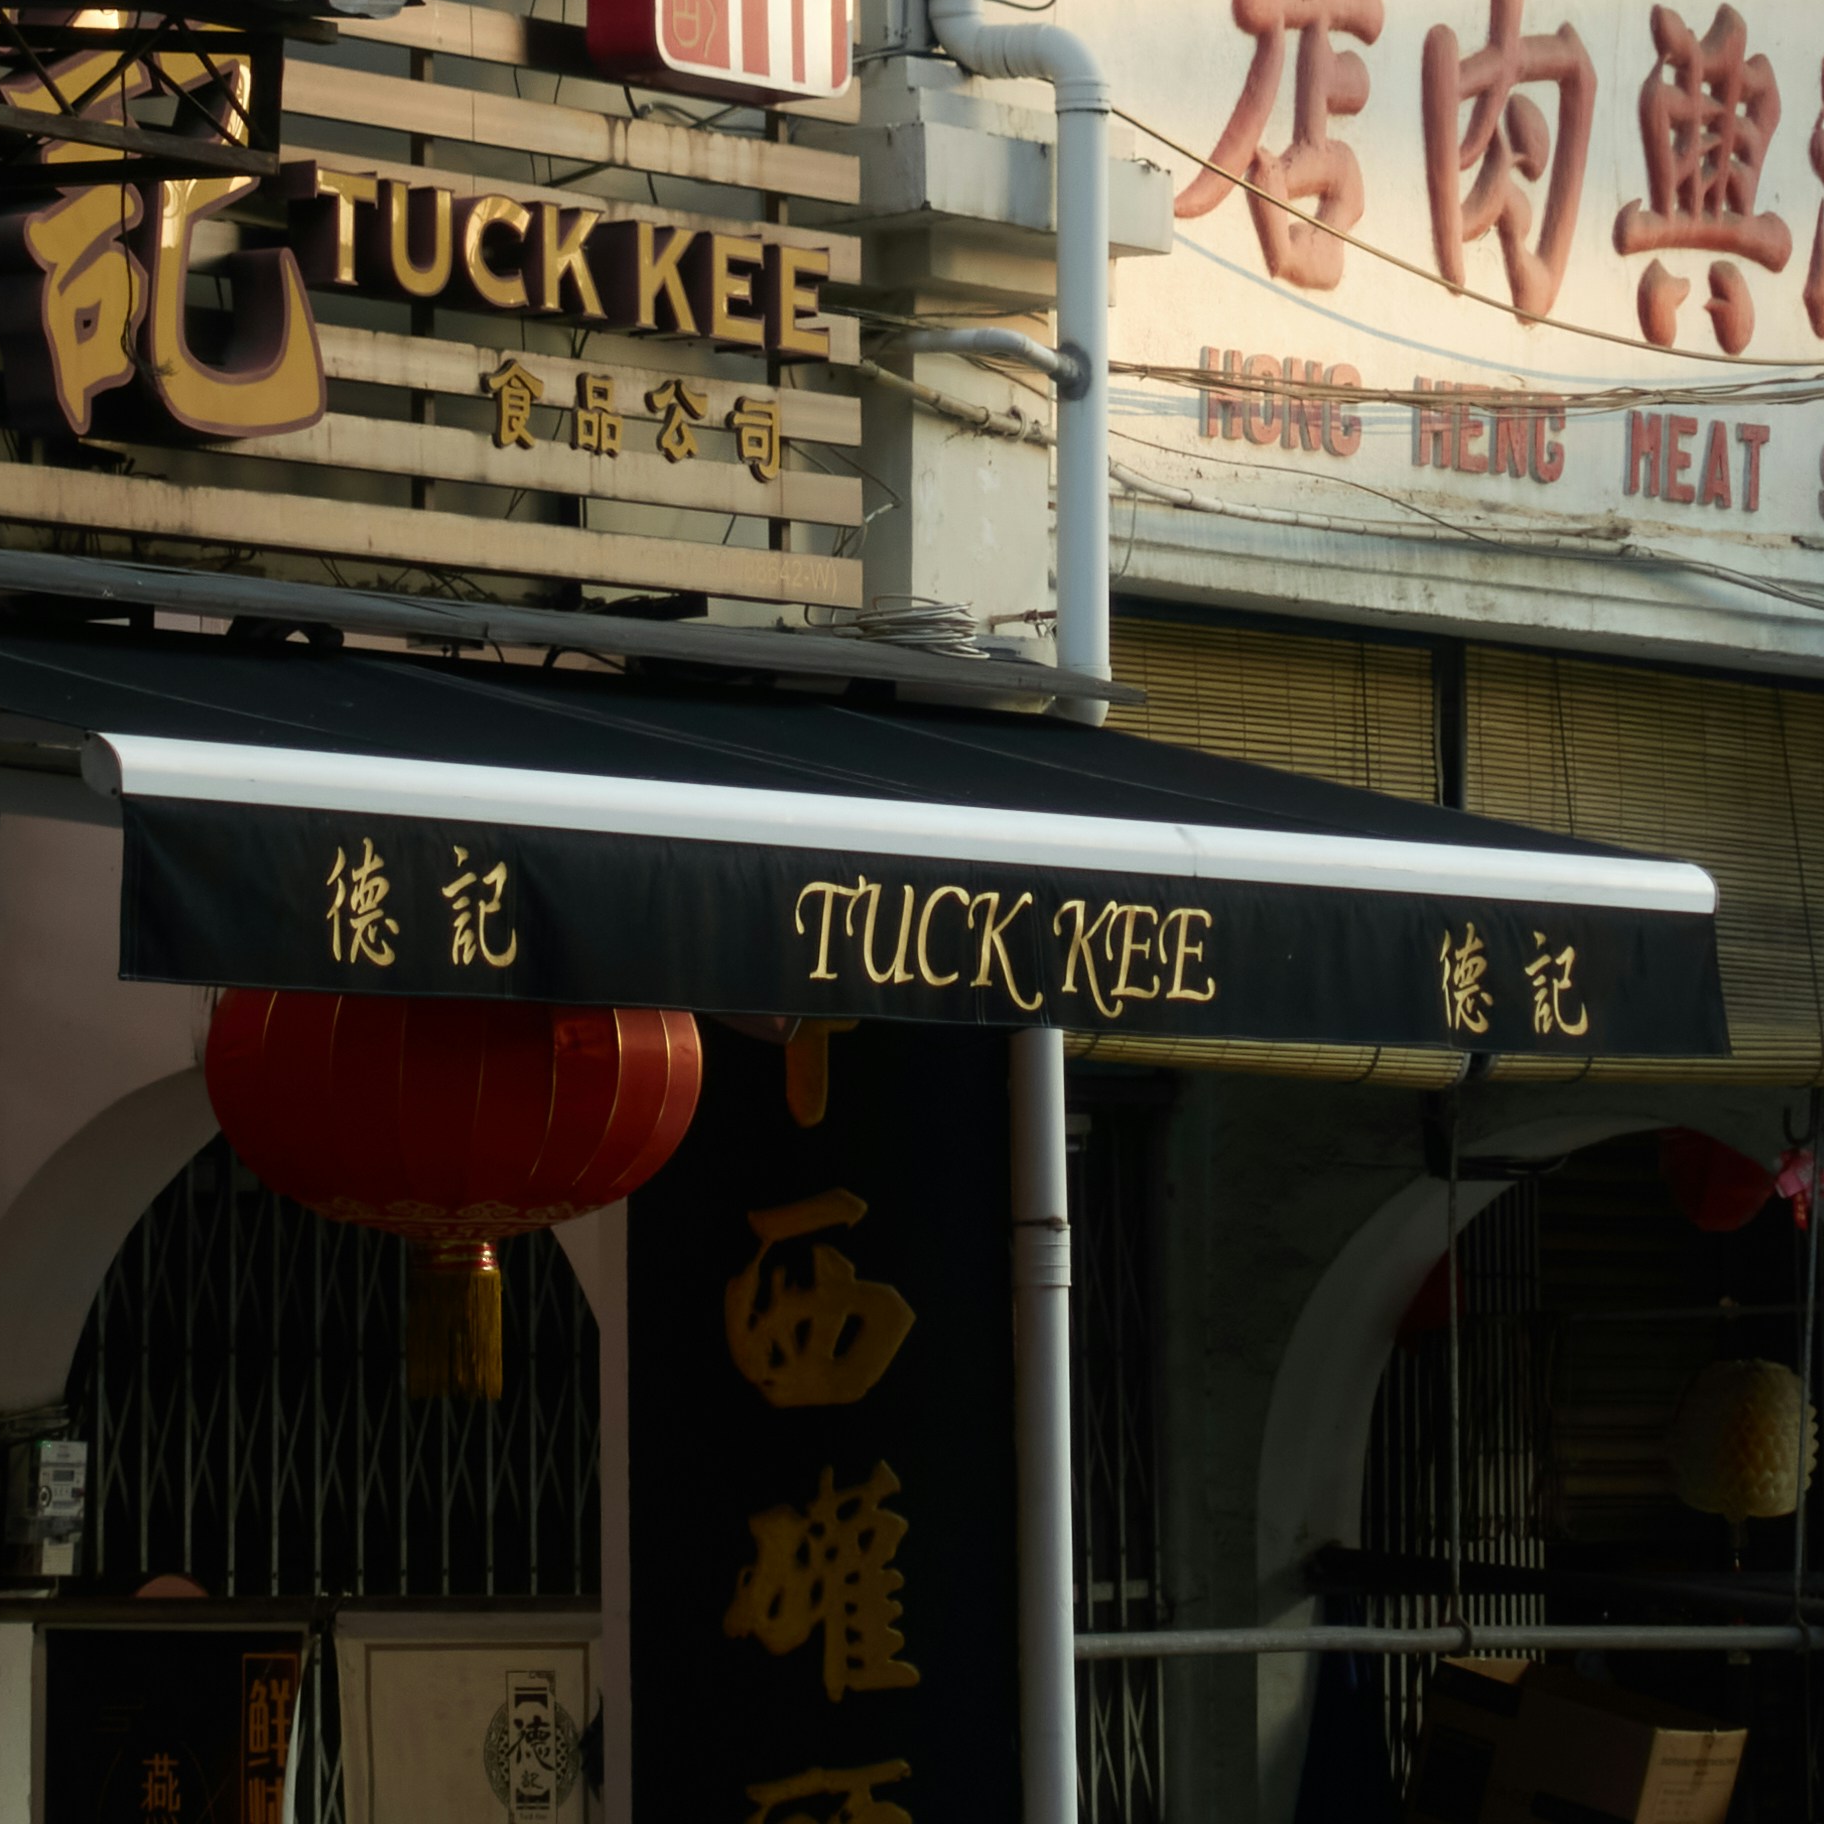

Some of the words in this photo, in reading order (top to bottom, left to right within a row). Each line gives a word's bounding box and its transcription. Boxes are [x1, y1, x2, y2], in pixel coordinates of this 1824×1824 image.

[296, 164, 609, 321] TUCK
[632, 218, 832, 360] KEE
[478, 357, 782, 484] 食品公司
[1198, 344, 1363, 458] HONG
[1412, 375, 1566, 485] HENG
[1624, 408, 1771, 513] MEAT
[326, 837, 519, 969] 德記
[793, 874, 1044, 1014] TUCK
[1053, 898, 1219, 1020] KEE
[1437, 921, 1590, 1038] 德記
